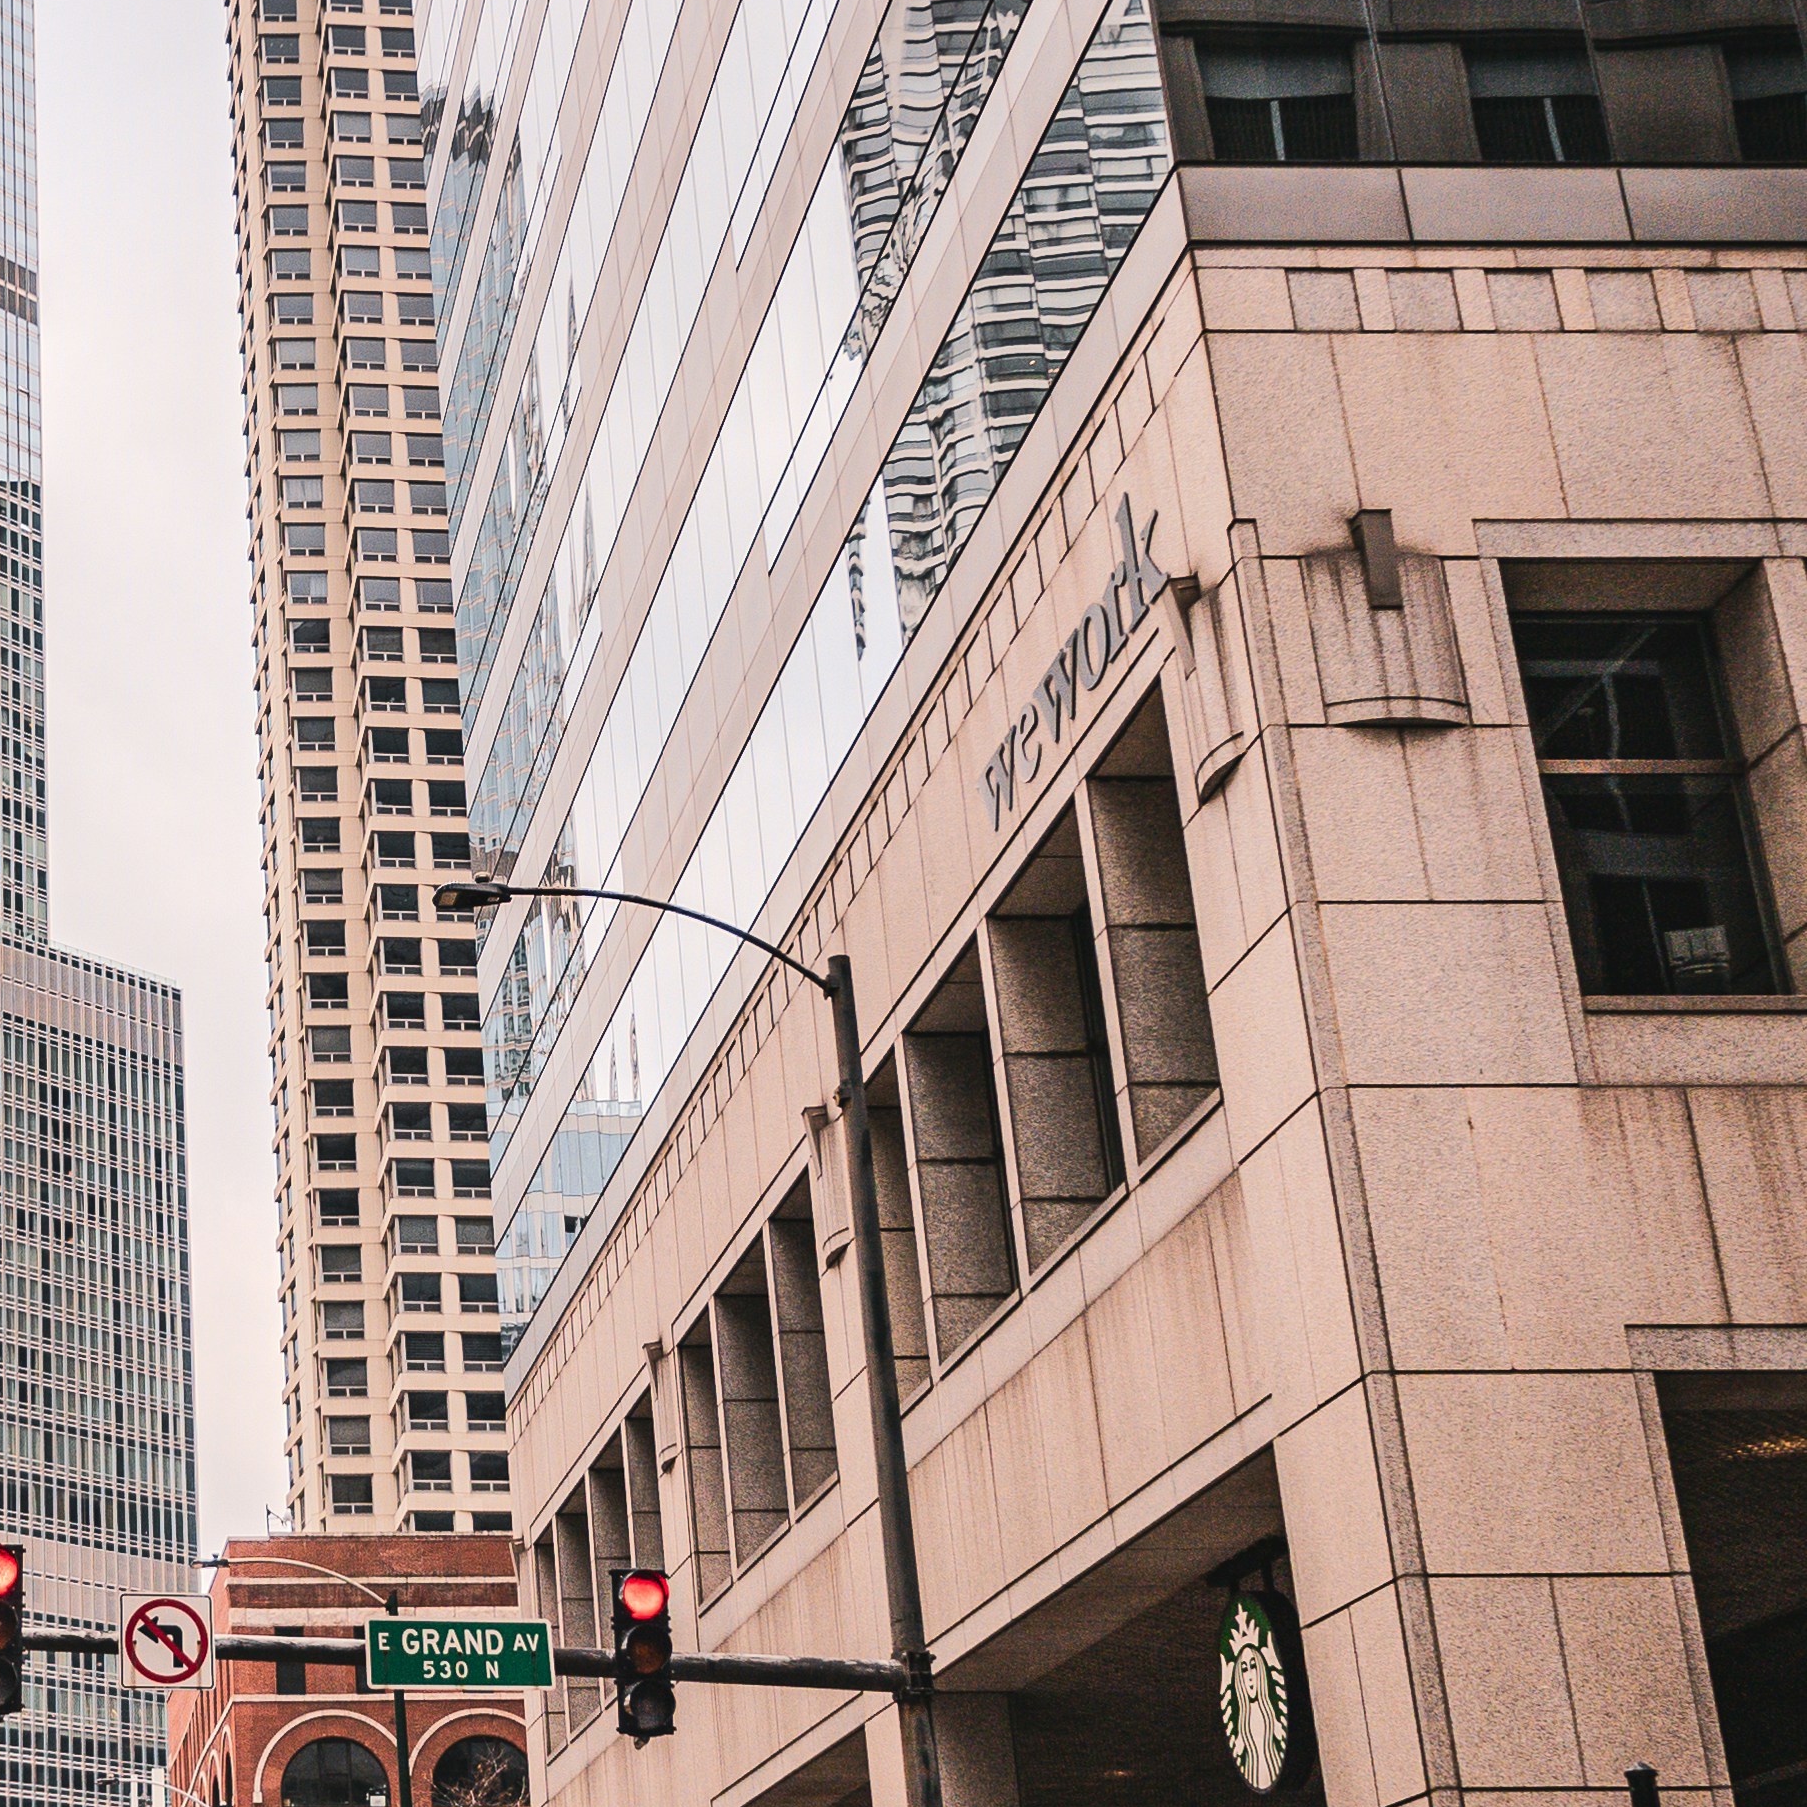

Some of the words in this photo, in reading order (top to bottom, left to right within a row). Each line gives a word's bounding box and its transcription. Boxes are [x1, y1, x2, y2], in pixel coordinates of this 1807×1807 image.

[977, 491, 1171, 833] wework
[378, 1632, 390, 1651] E
[401, 1628, 504, 1655] GRAND
[513, 1633, 539, 1652] AV
[423, 1660, 468, 1679] 530
[485, 1660, 499, 1679] N
